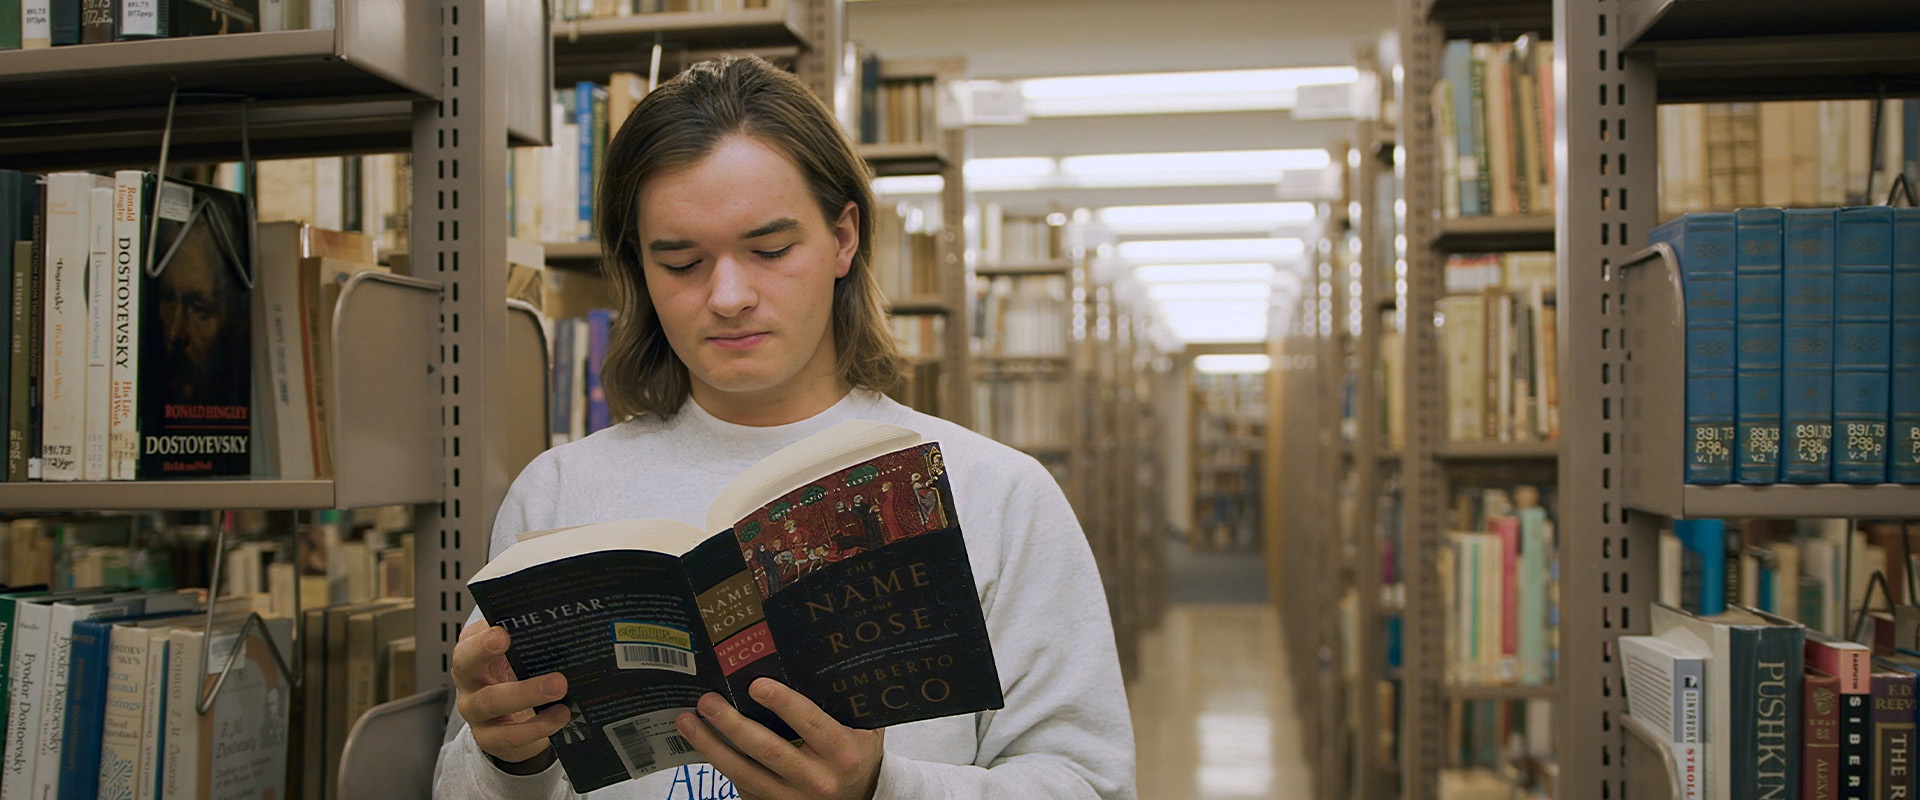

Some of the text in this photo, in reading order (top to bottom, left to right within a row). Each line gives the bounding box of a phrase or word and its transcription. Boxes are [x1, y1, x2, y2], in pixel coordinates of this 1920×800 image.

[116, 184, 127, 222] Hingley
[126, 187, 137, 222] Ronald
[115, 237, 132, 369] DOSTOYEVSKY
[113, 381, 122, 427] and Work
[121, 381, 132, 418] His Life
[165, 404, 248, 419] RONALD HINGLEY
[145, 435, 248, 455] DOSTOYEVSKY
[1696, 427, 1735, 441] 891.73
[1750, 428, 1780, 441] 891.73
[1796, 425, 1832, 438] 891.73
[1847, 424, 1886, 437] 891.73
[846, 561, 875, 576] THE
[701, 584, 753, 618] NAME
[717, 586, 730, 595] THE
[805, 562, 930, 622] NAME
[496, 598, 605, 631] THE YEAR
[712, 605, 756, 634] ROSE
[854, 602, 892, 618] OF THE
[718, 629, 766, 656] UMBERTO
[827, 607, 932, 655] ROSE
[172, 642, 184, 699] PACHMUSS
[728, 641, 765, 667] ECO
[832, 654, 953, 693] UMBERTO
[46, 636, 71, 754] Fyodor Dostoevsky
[849, 677, 950, 719] ECO
[1875, 698, 1917, 710] REEV
[10, 653, 36, 775] Fyodor Dostoevsky
[1686, 692, 1697, 744] SINYAVSKY
[1757, 661, 1786, 800] PUSHKIN
[1890, 733, 1908, 777] THE
[666, 764, 738, 800] Atla
